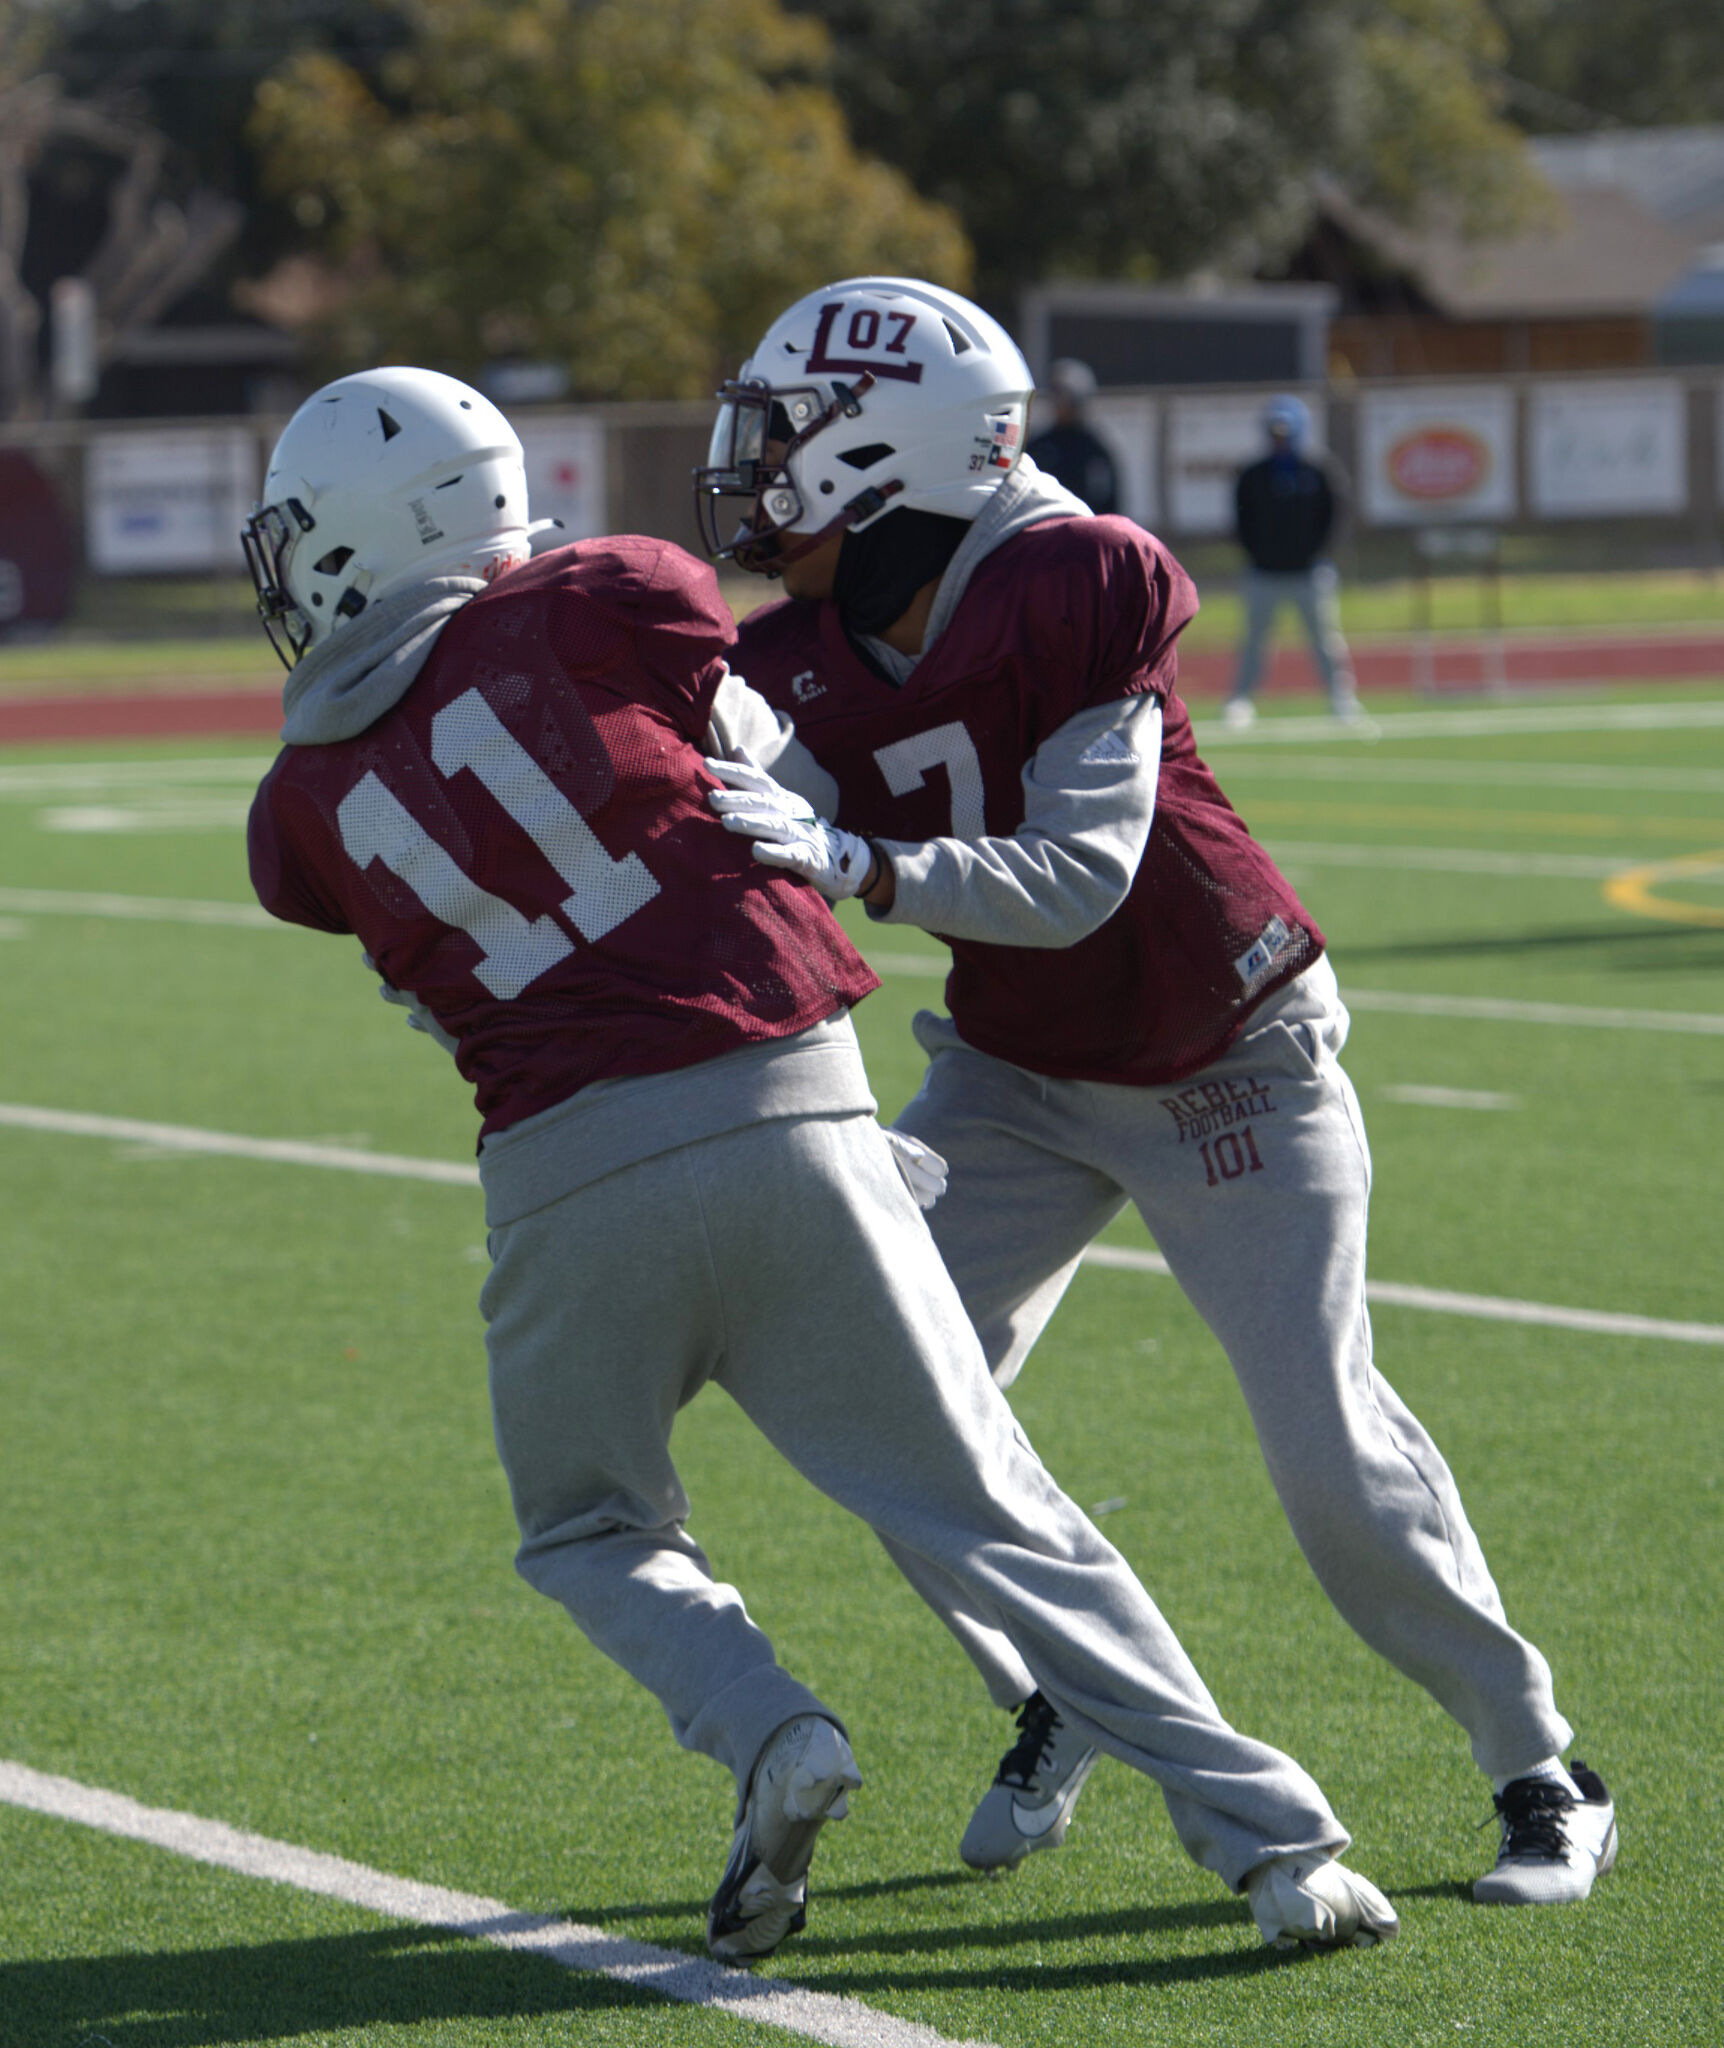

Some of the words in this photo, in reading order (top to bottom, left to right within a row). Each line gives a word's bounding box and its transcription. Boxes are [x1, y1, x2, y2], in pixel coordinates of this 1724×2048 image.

[847, 309, 917, 354] 07
[968, 453, 986, 472] 37
[872, 720, 987, 840] 7
[336, 686, 662, 1000] 11
[1158, 1077, 1271, 1121] REBEL
[1177, 1094, 1278, 1144] FOOTBALL
[1198, 1124, 1265, 1188] 101
